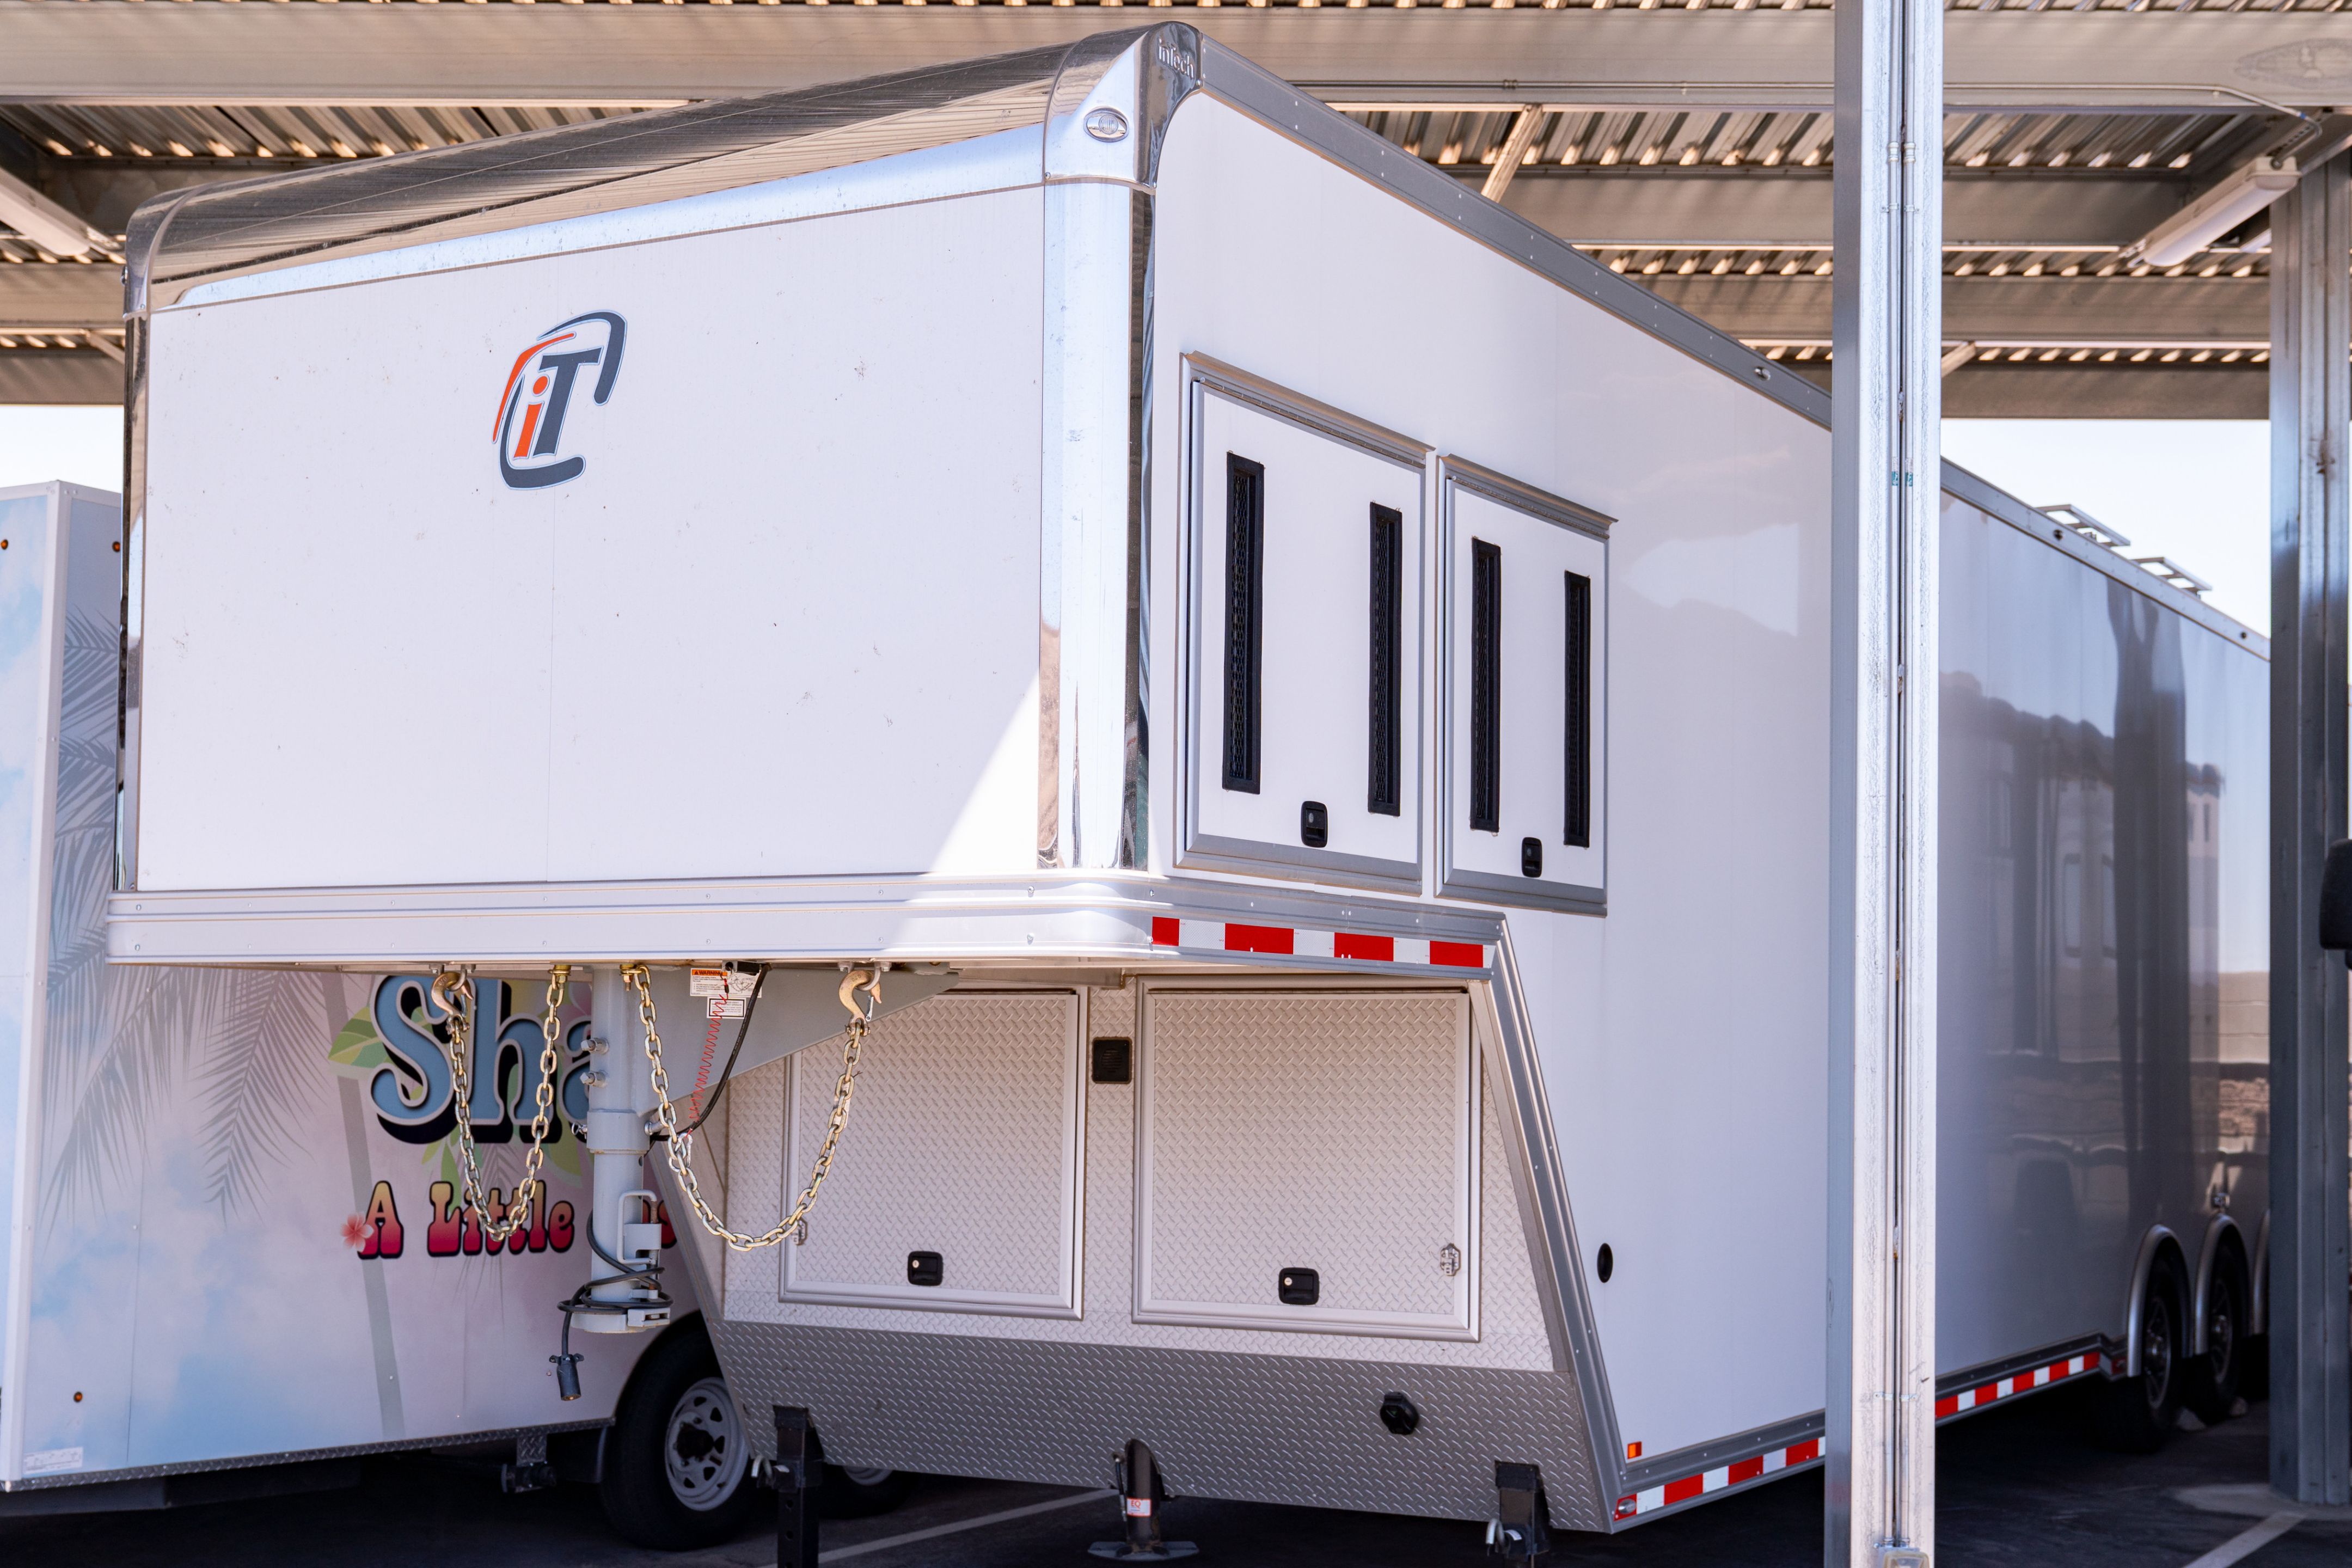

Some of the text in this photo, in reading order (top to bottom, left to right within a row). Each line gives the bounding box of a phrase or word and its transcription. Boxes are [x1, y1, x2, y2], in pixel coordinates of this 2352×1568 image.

[1158, 38, 1194, 79] inTech
[357, 1180, 404, 1259] A
[427, 1179, 575, 1257] Little
